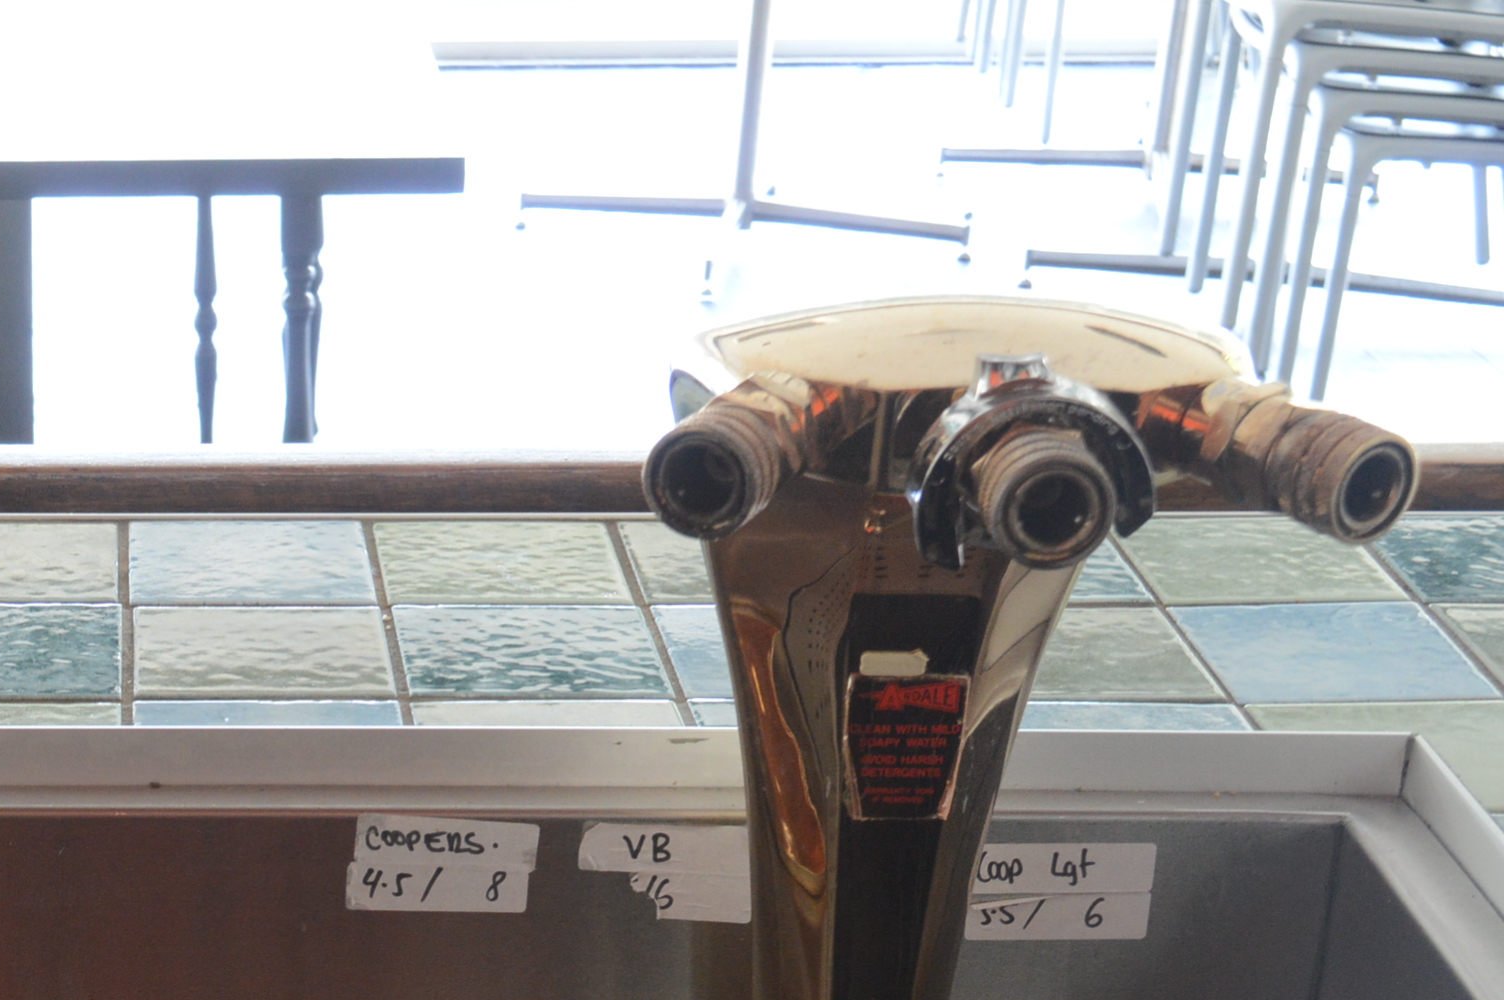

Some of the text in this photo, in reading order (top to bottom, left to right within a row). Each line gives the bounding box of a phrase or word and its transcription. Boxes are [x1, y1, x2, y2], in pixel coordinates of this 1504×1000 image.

[849, 724, 961, 735] CLEAN WITH MILD
[859, 738, 947, 748] SOAPY WATER
[860, 755, 945, 765] AVOID HARSH
[861, 767, 942, 778] DETERGENTS
[622, 832, 672, 863] VB
[976, 851, 1023, 884] Coop
[485, 870, 507, 902] 8
[1084, 897, 1105, 929] 6
